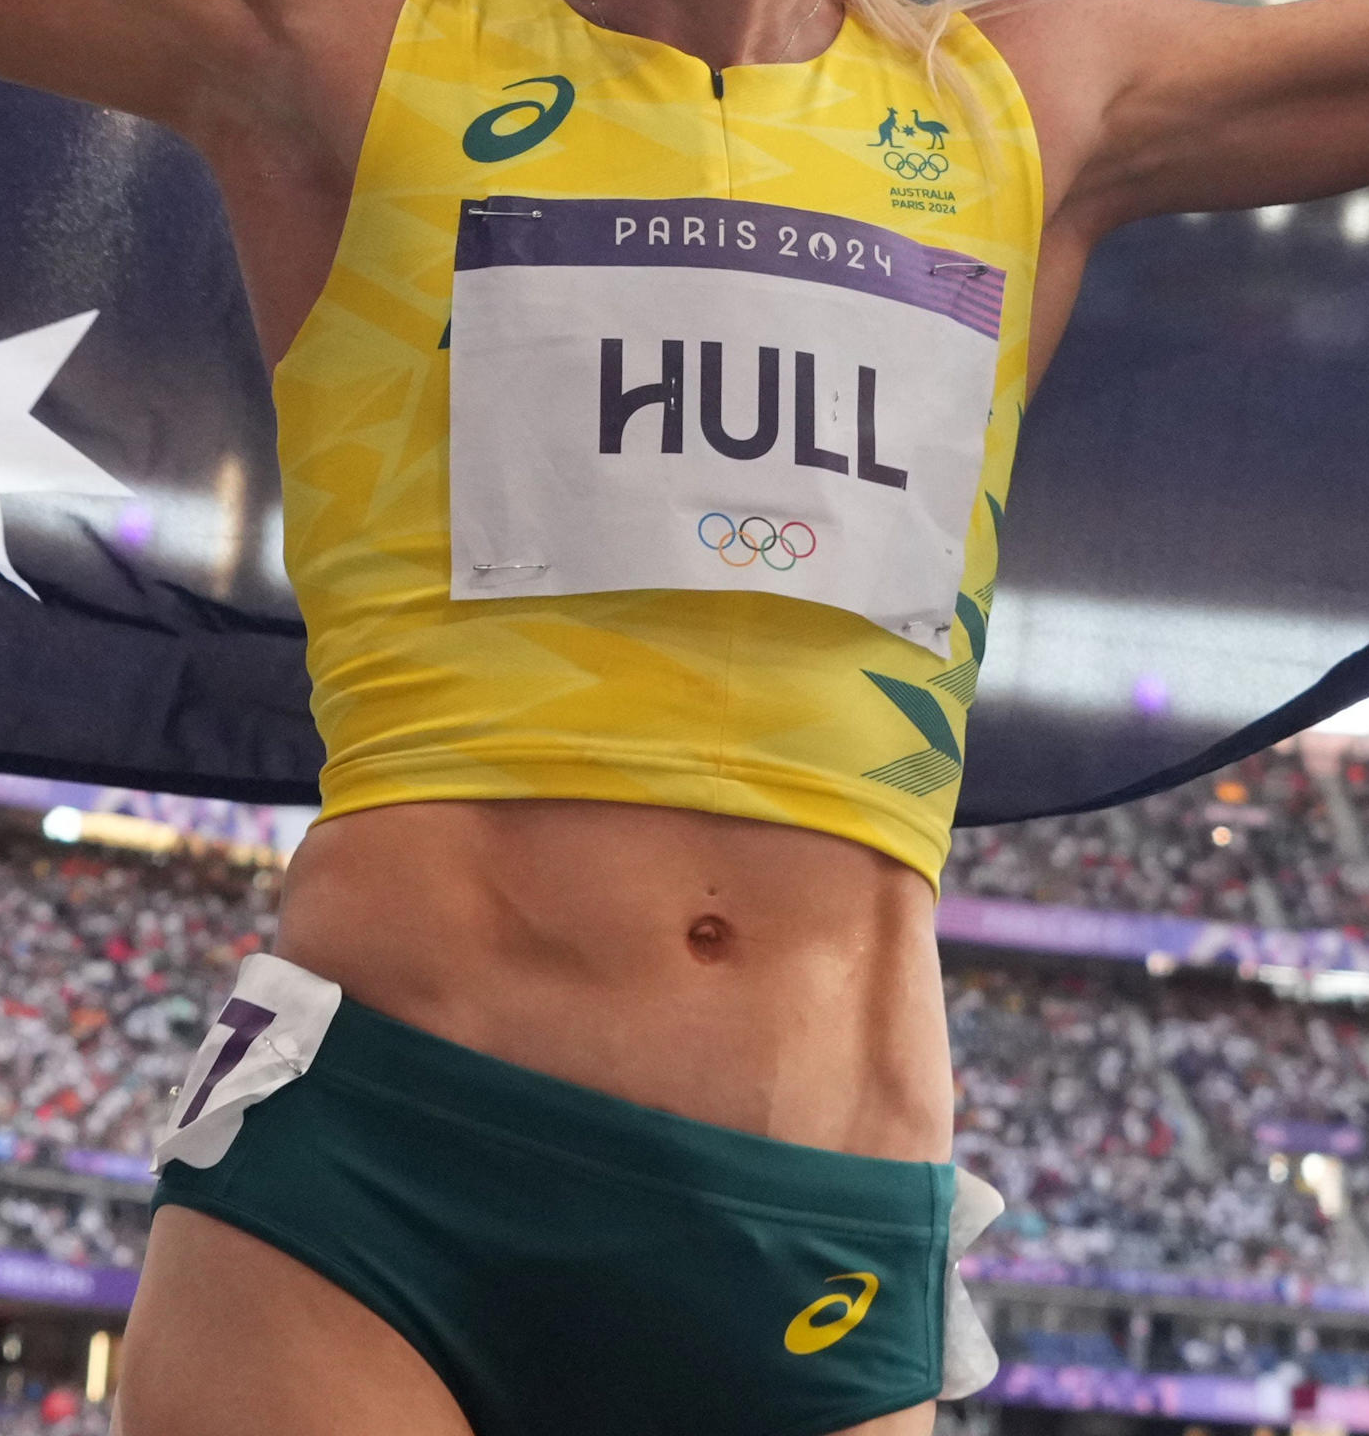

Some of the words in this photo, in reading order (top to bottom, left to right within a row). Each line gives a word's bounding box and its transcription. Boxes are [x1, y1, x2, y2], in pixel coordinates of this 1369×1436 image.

[890, 187, 956, 201] AUSTRALIA
[891, 199, 926, 211] PARIS
[928, 202, 957, 215] 2024
[778, 225, 892, 276] 2024
[599, 338, 908, 491] HULL
[177, 997, 277, 1129] 7
